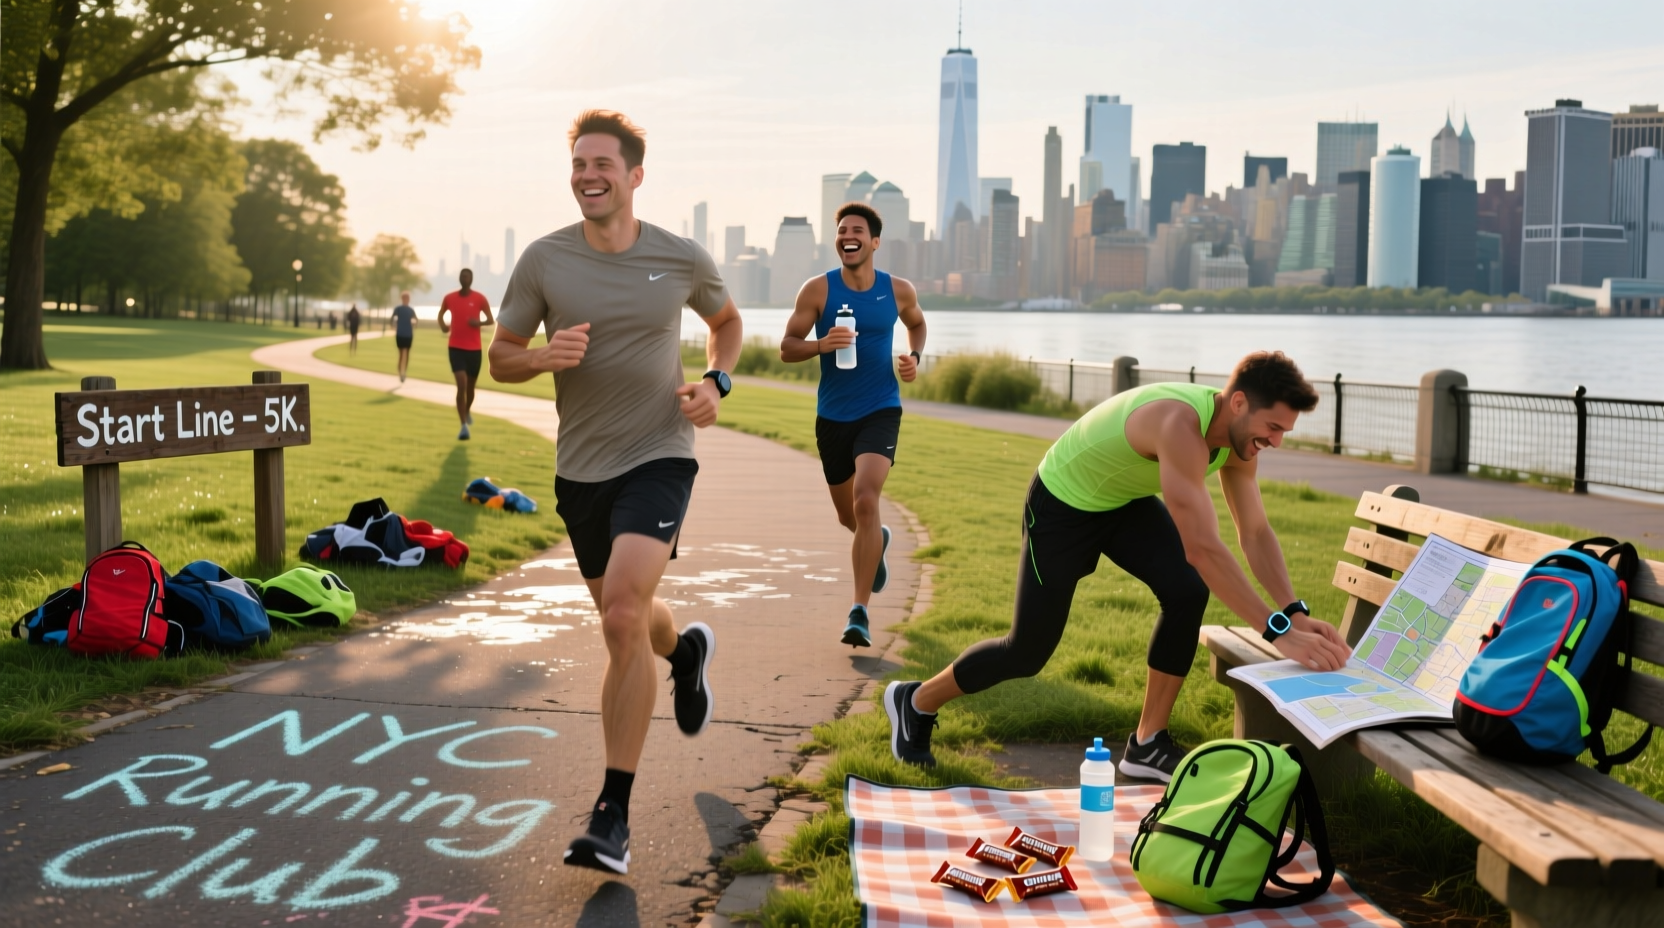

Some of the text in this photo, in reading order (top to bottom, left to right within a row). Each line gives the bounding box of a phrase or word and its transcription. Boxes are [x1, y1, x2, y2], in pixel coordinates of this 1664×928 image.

[77, 403, 165, 447] Start
[176, 400, 235, 439] Line
[209, 709, 559, 770] NYC
[62, 753, 556, 860] Running
[41, 825, 400, 912] Club
